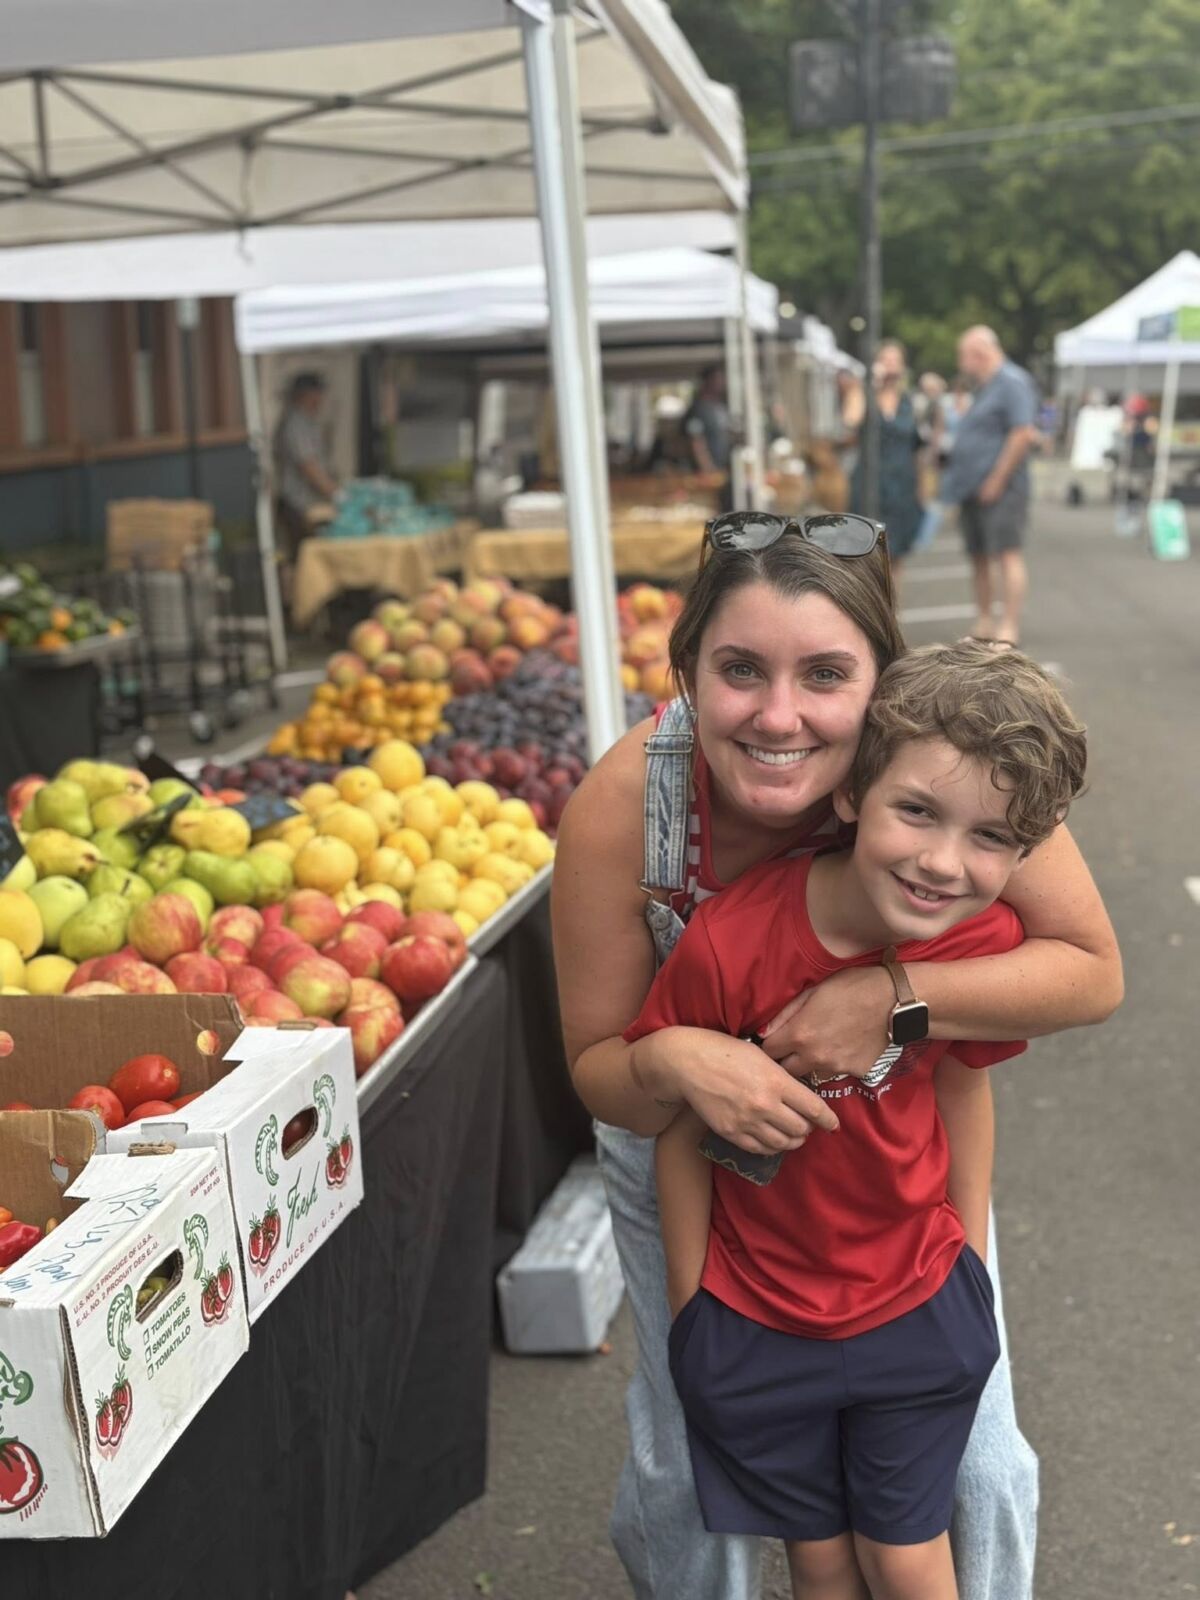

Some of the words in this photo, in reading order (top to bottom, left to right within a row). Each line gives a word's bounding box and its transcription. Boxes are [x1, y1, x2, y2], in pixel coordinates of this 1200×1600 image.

[843, 1086, 853, 1096] OF
[287, 1160, 320, 1249] Fresh
[100, 1256, 128, 1285] PRODUCE
[128, 1247, 137, 1259] OF
[106, 1265, 133, 1295] PRODUIT
[133, 1254, 146, 1269] DES
[263, 1241, 304, 1293] PRODUCE
[308, 1226, 318, 1243] OF
[151, 1292, 187, 1335] TOMATOES
[152, 1325, 173, 1354] SNOW
[173, 1306, 191, 1331] PEAS
[155, 1325, 191, 1370] TOMATILLO
